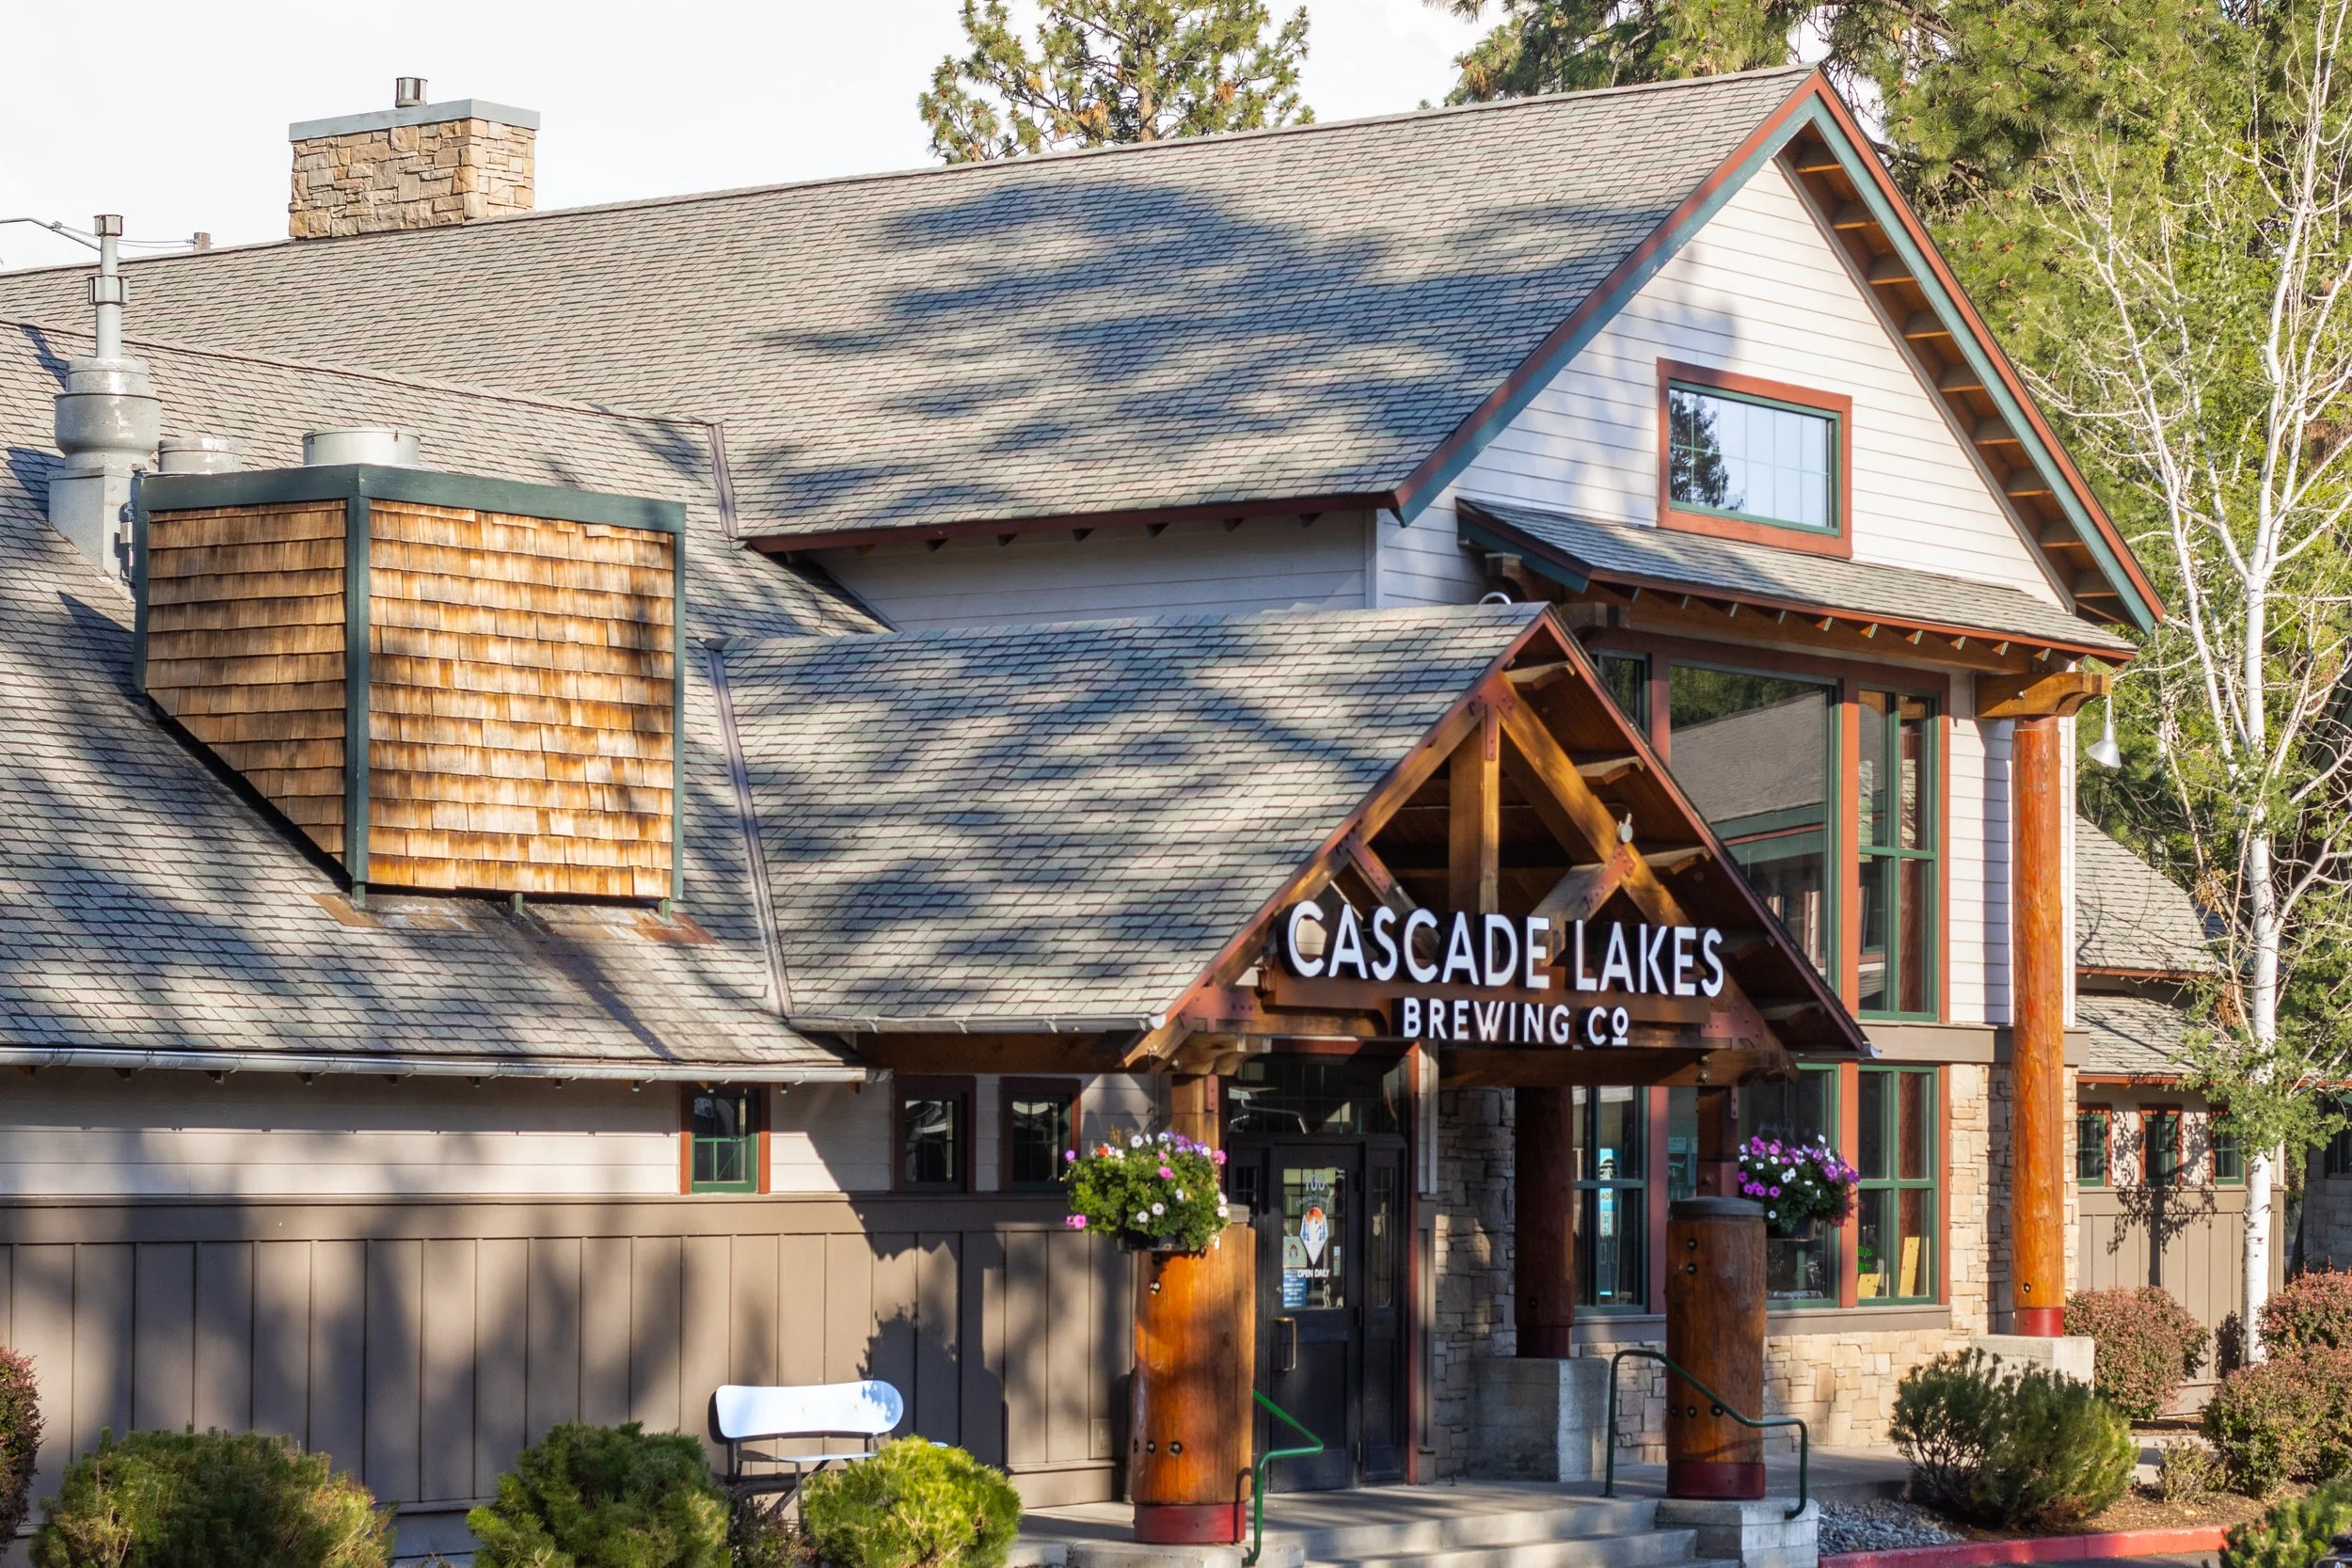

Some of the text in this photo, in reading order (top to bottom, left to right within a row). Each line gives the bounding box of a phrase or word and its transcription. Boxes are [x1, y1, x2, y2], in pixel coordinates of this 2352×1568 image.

[1288, 900, 1724, 997] CASCADE LAKES
[1403, 997, 1570, 1044] BREWING
[1297, 1269, 1313, 1278] OPEN
